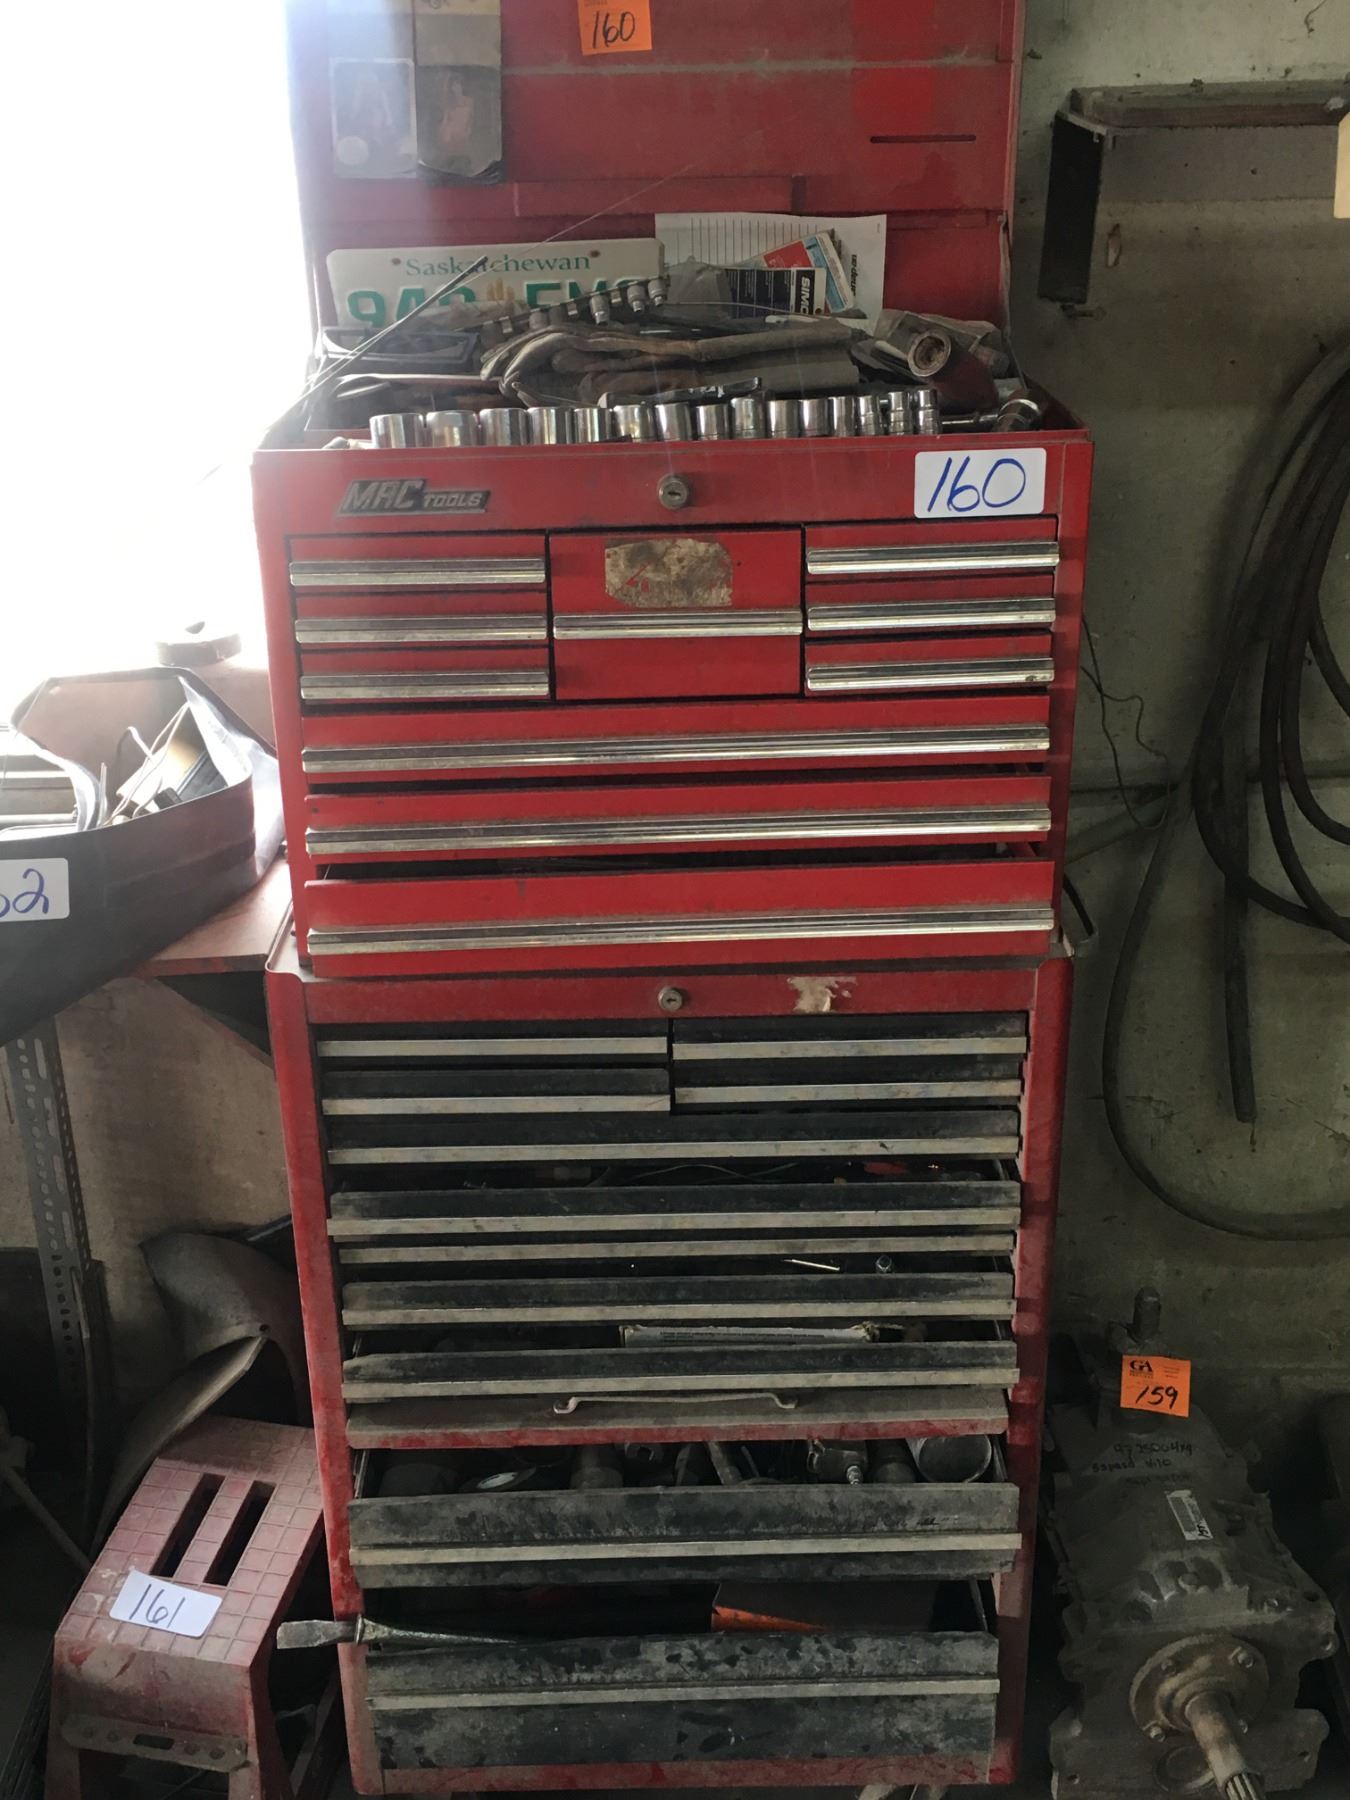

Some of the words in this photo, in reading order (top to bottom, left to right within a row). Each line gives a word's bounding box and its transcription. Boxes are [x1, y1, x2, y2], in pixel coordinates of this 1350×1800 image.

[592, 11, 636, 48] 160
[342, 480, 424, 510] MAC
[423, 493, 483, 508] TOOLS
[927, 456, 1026, 513] 160
[1129, 1359, 1153, 1373] GA
[1136, 1385, 1179, 1410] 159
[128, 1583, 186, 1629] 161
